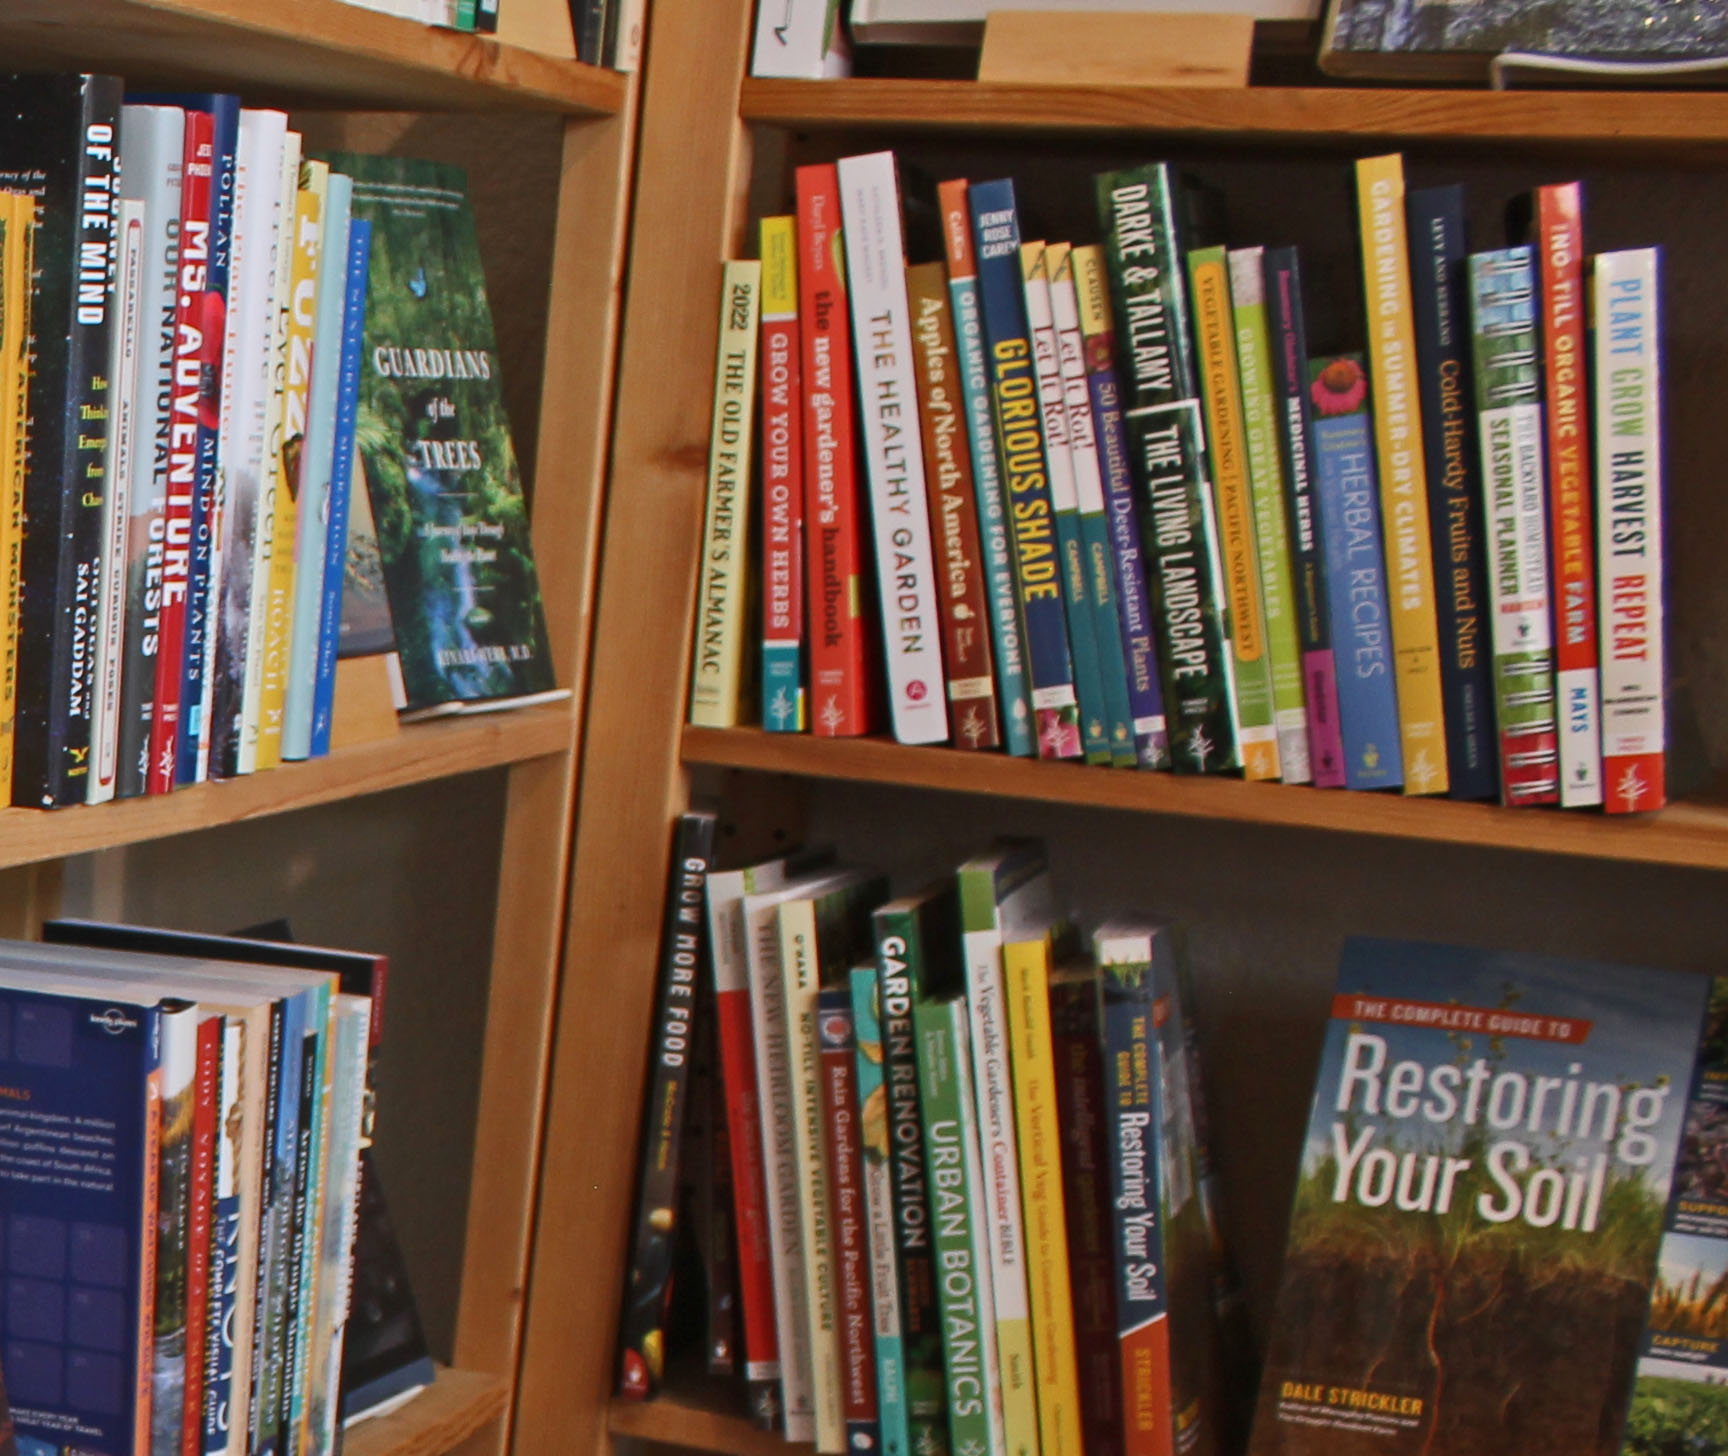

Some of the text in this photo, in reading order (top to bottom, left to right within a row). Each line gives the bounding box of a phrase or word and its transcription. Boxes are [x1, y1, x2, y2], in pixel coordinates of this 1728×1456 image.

[77, 124, 112, 325] OF THE MIND
[1112, 183, 1172, 391] DARKE & TALLAMY
[374, 346, 491, 381] GUARDIANS
[726, 351, 745, 393] THE
[730, 284, 751, 330] 2022
[815, 291, 834, 330] the
[815, 336, 831, 389] new
[870, 310, 895, 367] THE
[161, 222, 210, 608] MS. ADVENTURE
[417, 439, 481, 472] TREES
[721, 400, 742, 444] OLD
[770, 333, 789, 629] GROW YOUR OWN HERBS
[878, 380, 912, 515] HEALTHY
[912, 298, 971, 598] Apples of North America
[994, 338, 1058, 603] GLORIOUS SHADE
[1609, 279, 1647, 661] PLANT GROW HARVEST REPEAT
[892, 529, 923, 655] GARDEN
[1144, 423, 1209, 680] THE LIVING LANDSCAPE
[1341, 454, 1385, 679] HERBAL RECIPES
[702, 570, 728, 674] ALMANAC
[662, 856, 706, 1067] GROW MORE FOOD
[1354, 1001, 1571, 1039] THE COMPLETE GUIDE TO
[882, 936, 927, 1248] GARDEN RENOVATION
[1336, 1034, 1670, 1166] Restoring
[1331, 1122, 1607, 1231] Your Soil
[932, 1121, 983, 1416] URBAN BOTANICS
